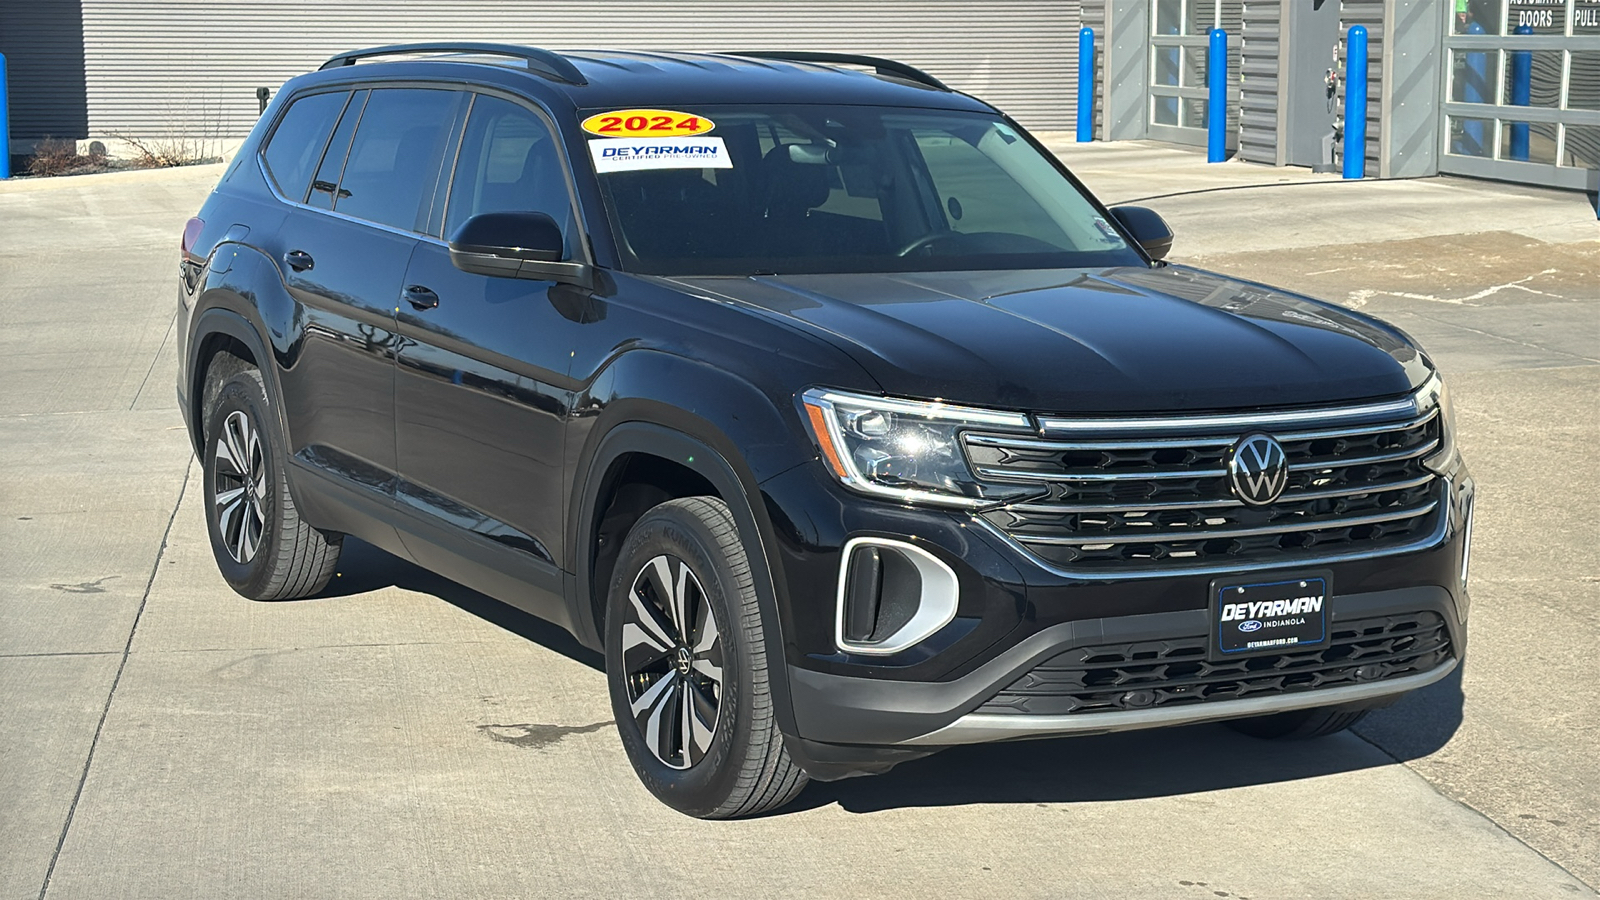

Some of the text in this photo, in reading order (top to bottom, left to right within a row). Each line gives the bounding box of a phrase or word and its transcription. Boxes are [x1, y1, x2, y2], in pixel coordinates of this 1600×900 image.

[1519, 10, 1553, 27] DOORS
[1574, 9, 1598, 27] PULL
[598, 116, 701, 132] 2024
[602, 146, 718, 157] DEYARMAN
[663, 526, 705, 568] KUMHO
[1221, 596, 1324, 622] DEYARMAN
[1241, 617, 1306, 631] Ford INDIANOLA
